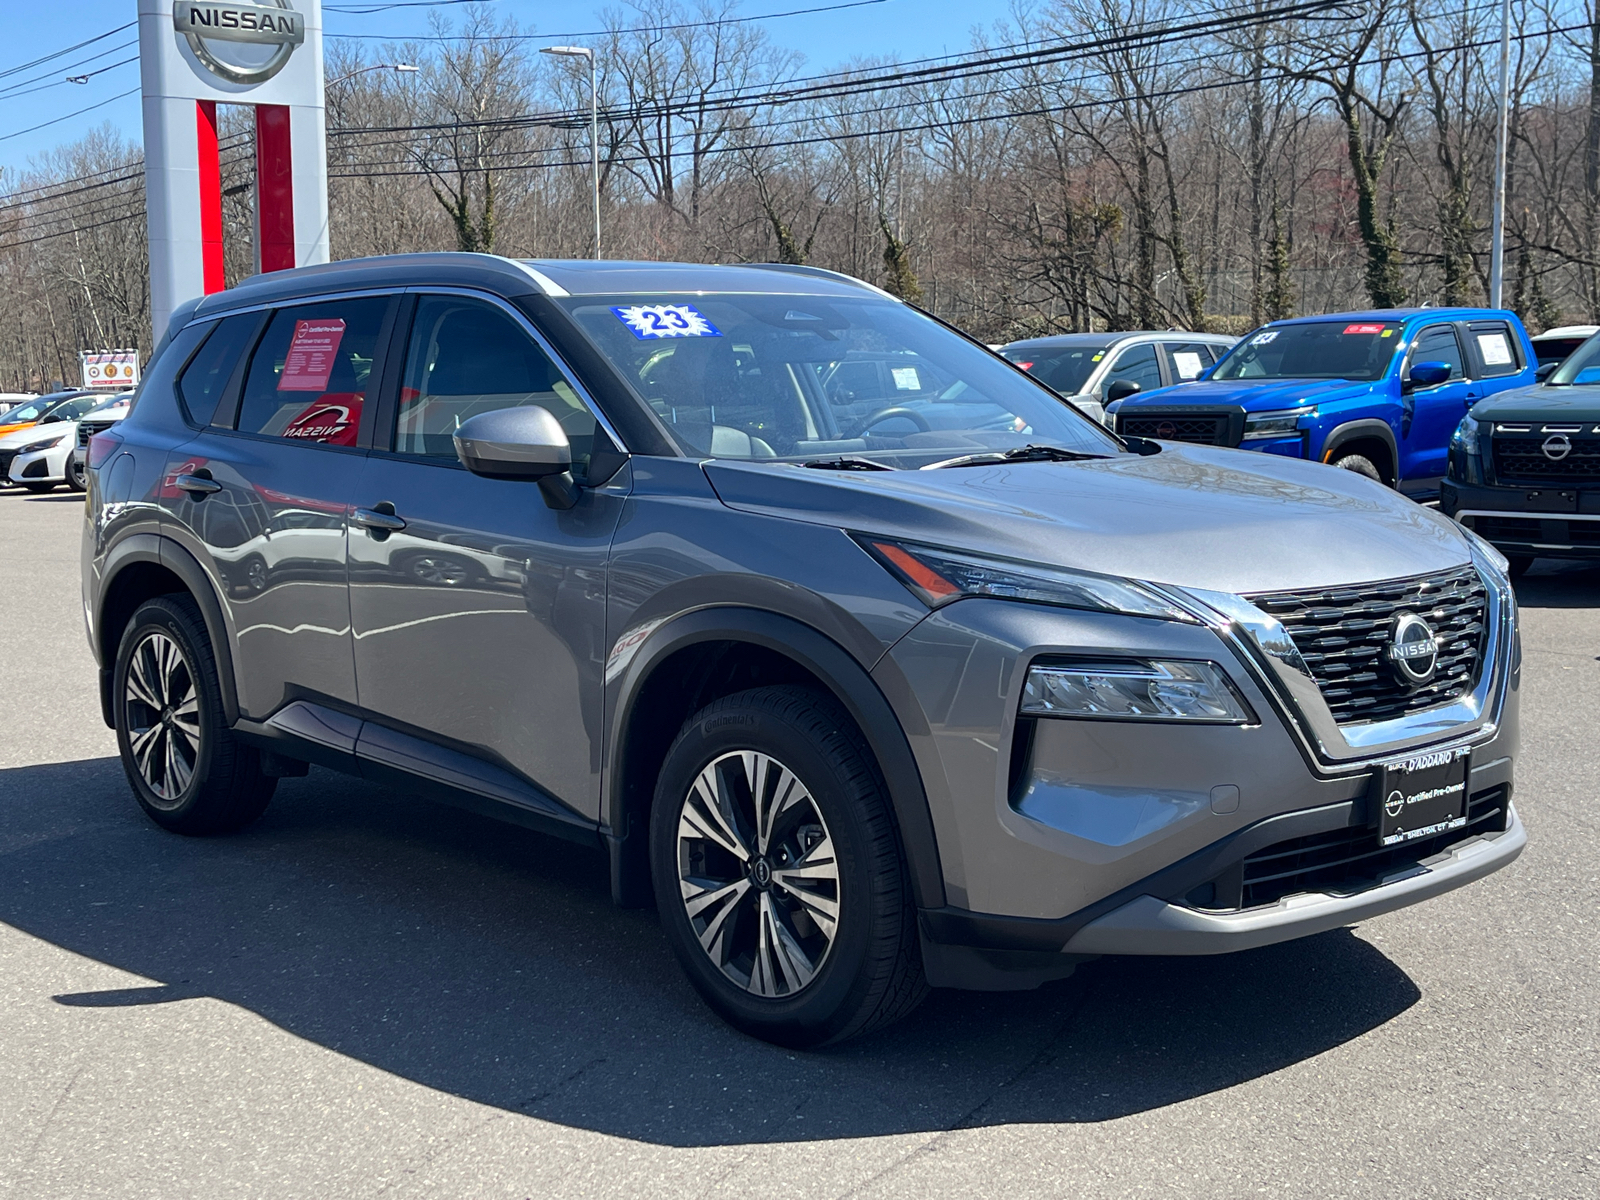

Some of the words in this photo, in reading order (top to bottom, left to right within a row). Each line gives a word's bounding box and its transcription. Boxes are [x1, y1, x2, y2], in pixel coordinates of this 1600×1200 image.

[190, 8, 295, 34] NISSAN
[641, 310, 690, 330] 23
[1393, 641, 1439, 658] NISSAN
[1408, 751, 1452, 771] D'ADDARIO
[1407, 789, 1433, 804] Certified
[1433, 781, 1465, 797] Pre-Owned
[1385, 799, 1404, 809] NISSAN
